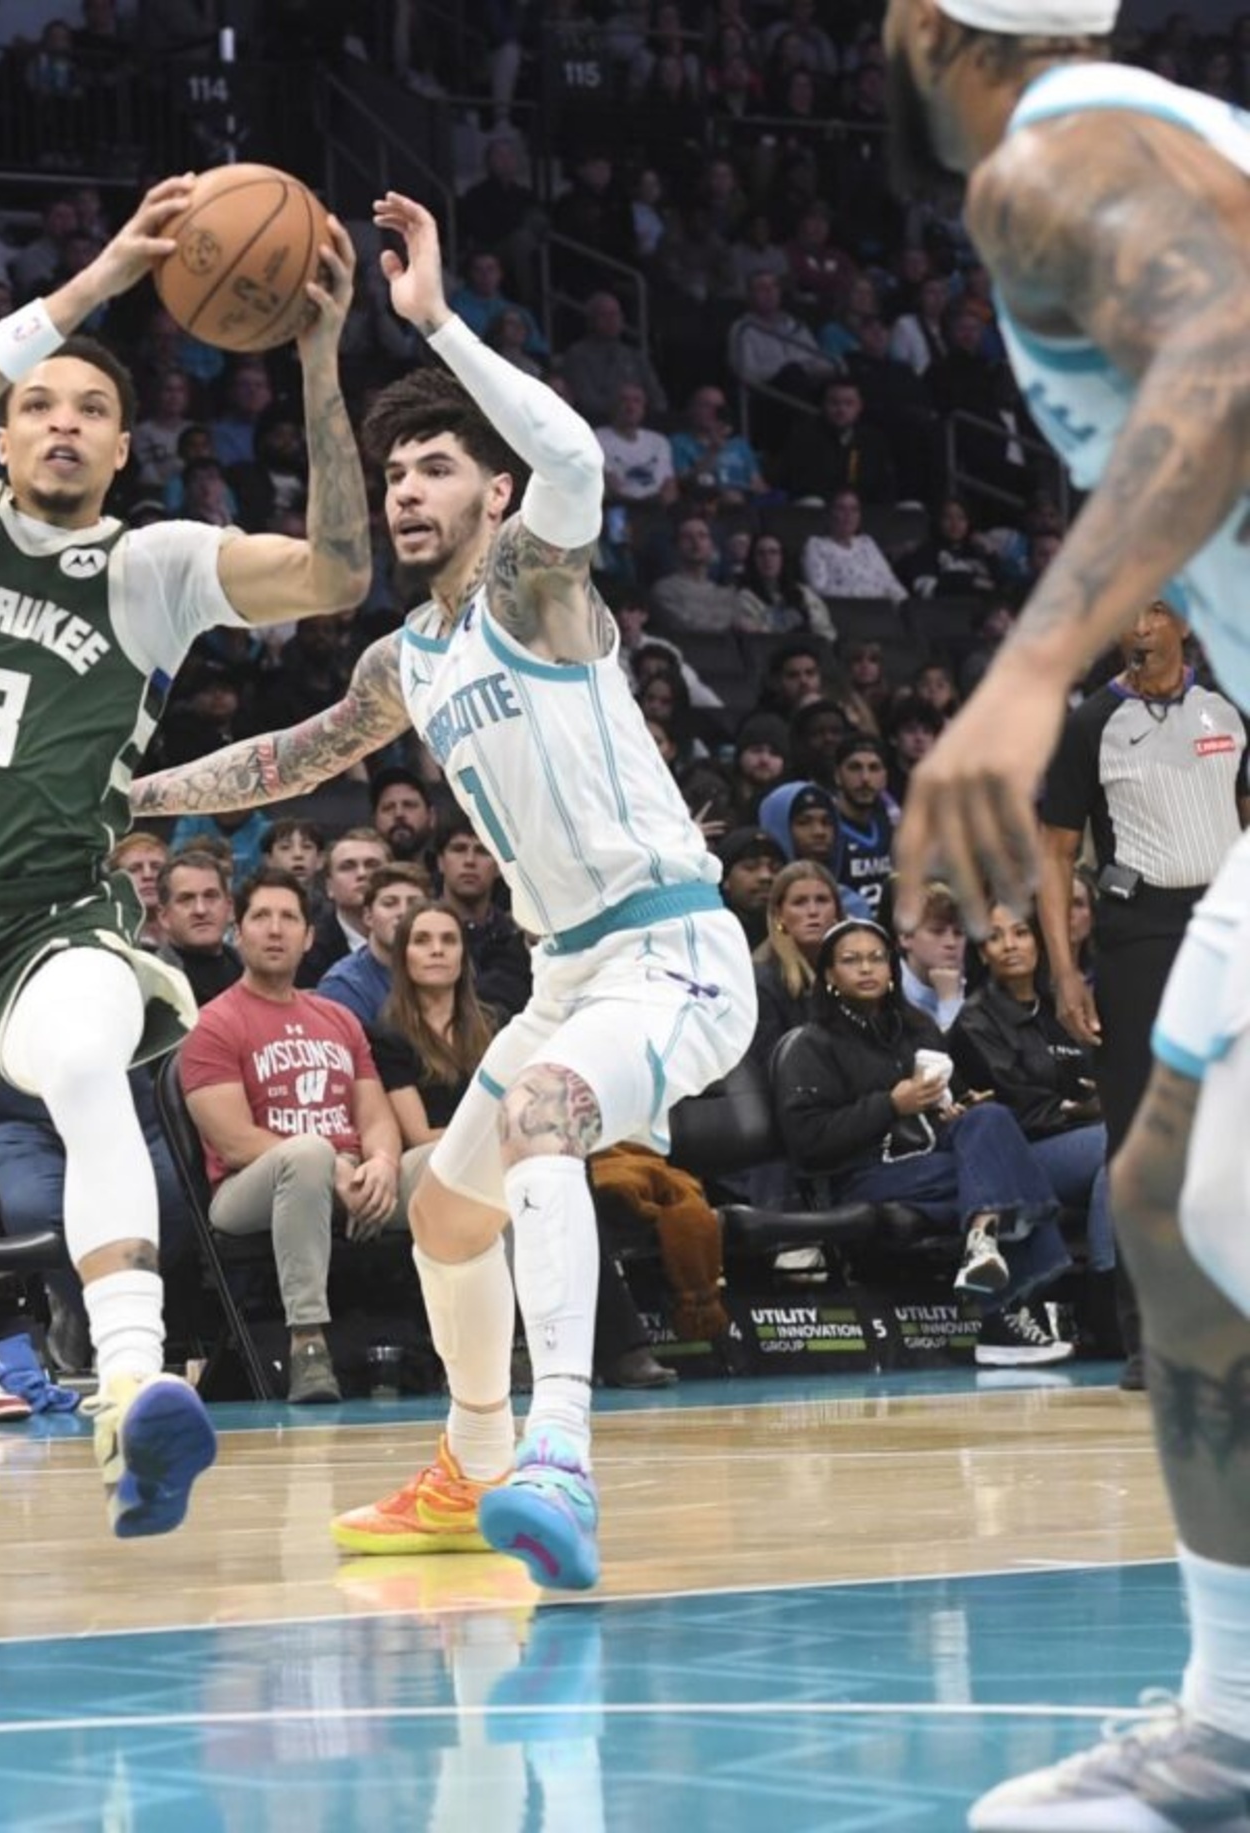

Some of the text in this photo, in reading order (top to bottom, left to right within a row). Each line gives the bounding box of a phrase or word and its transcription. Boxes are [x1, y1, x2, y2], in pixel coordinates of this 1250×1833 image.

[564, 61, 602, 88] 115
[189, 76, 229, 102] 114
[457, 765, 517, 863] 1
[751, 1308, 818, 1324] UTILITY
[895, 1305, 958, 1320] UTILITY
[777, 1324, 864, 1338] INNOVATION
[872, 1318, 888, 1338] 5
[921, 1320, 982, 1334] INNOVAT
[760, 1340, 805, 1352] GROUP
[904, 1337, 947, 1349] GROUP
